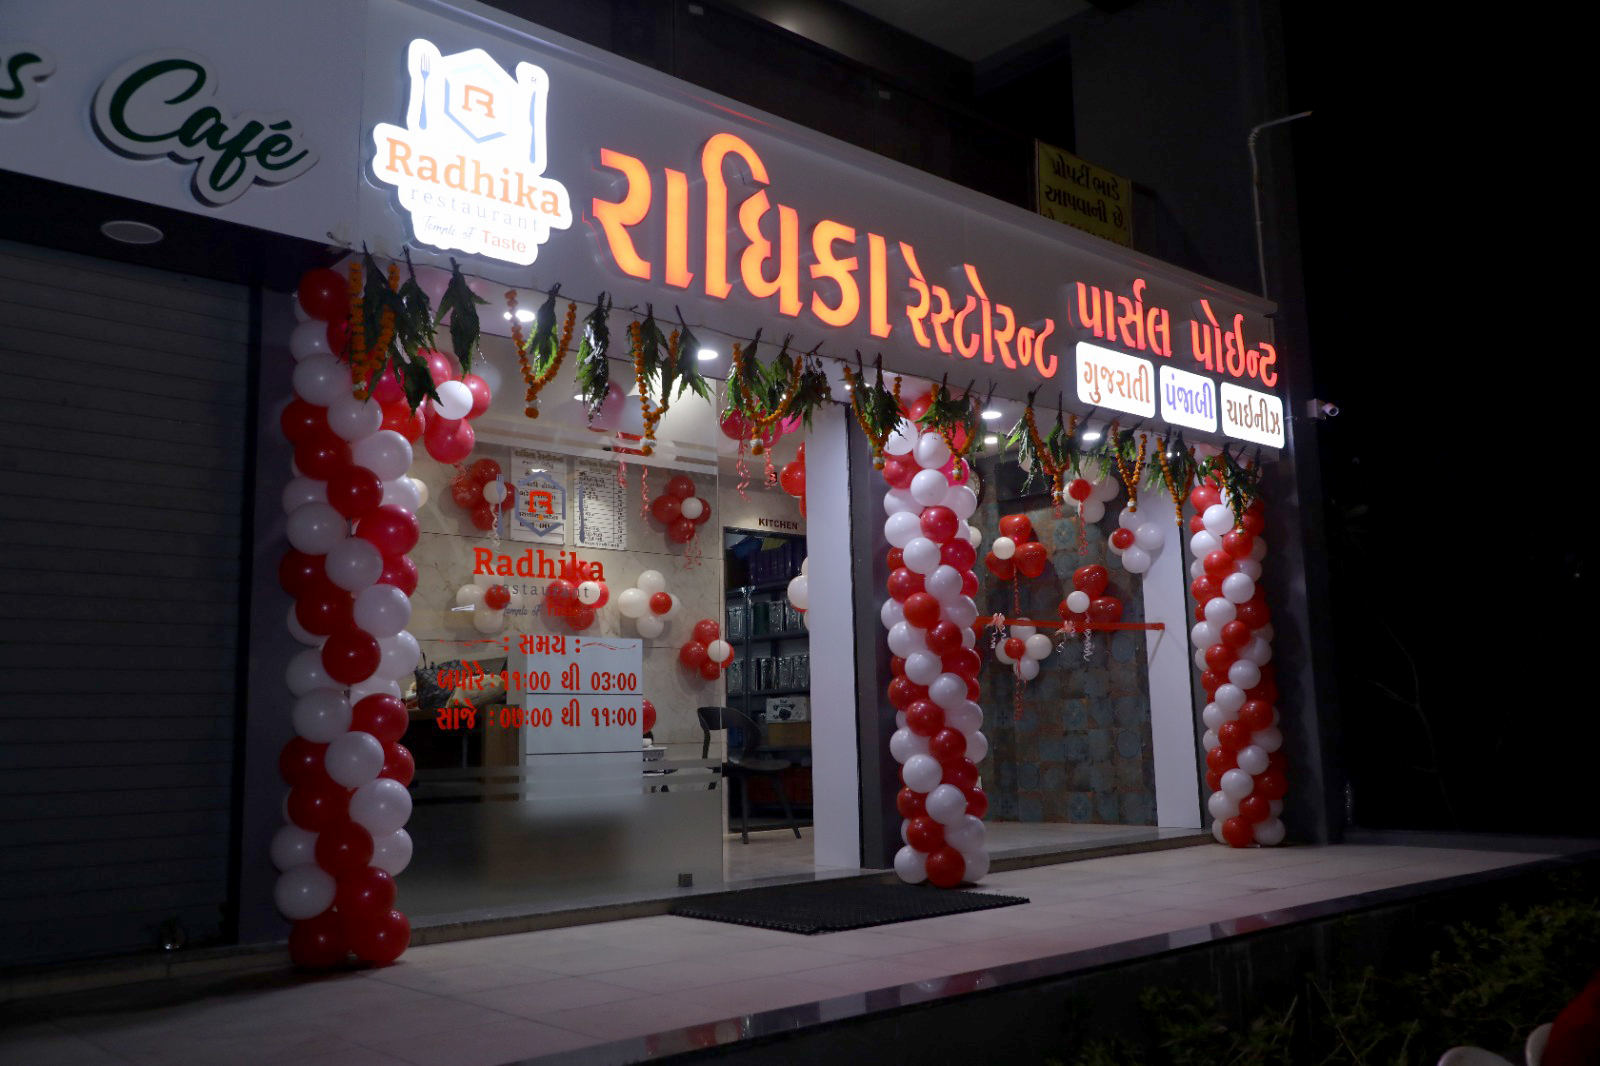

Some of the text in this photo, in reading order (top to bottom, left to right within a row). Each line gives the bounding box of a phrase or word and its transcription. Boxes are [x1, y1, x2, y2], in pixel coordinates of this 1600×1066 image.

[109, 58, 309, 192] Café
[385, 137, 561, 217] Radhika
[410, 187, 538, 232] restaurant
[423, 215, 457, 238] Temple
[481, 229, 527, 253] Taste
[593, 132, 1058, 378] રાધિકા રેસ્ટોરન્ટ
[1076, 278, 1172, 358] પાર્સલ
[1083, 364, 1150, 404] ગુજરાતી
[1165, 373, 1214, 419] પંજાબી
[758, 517, 798, 530] KITCHEN
[473, 547, 605, 582] Radhika
[492, 583, 589, 598] restaurant
[518, 634, 566, 655] સમય
[561, 662, 580, 691] થી
[435, 698, 477, 730] સાંજે
[561, 698, 580, 726] થી
